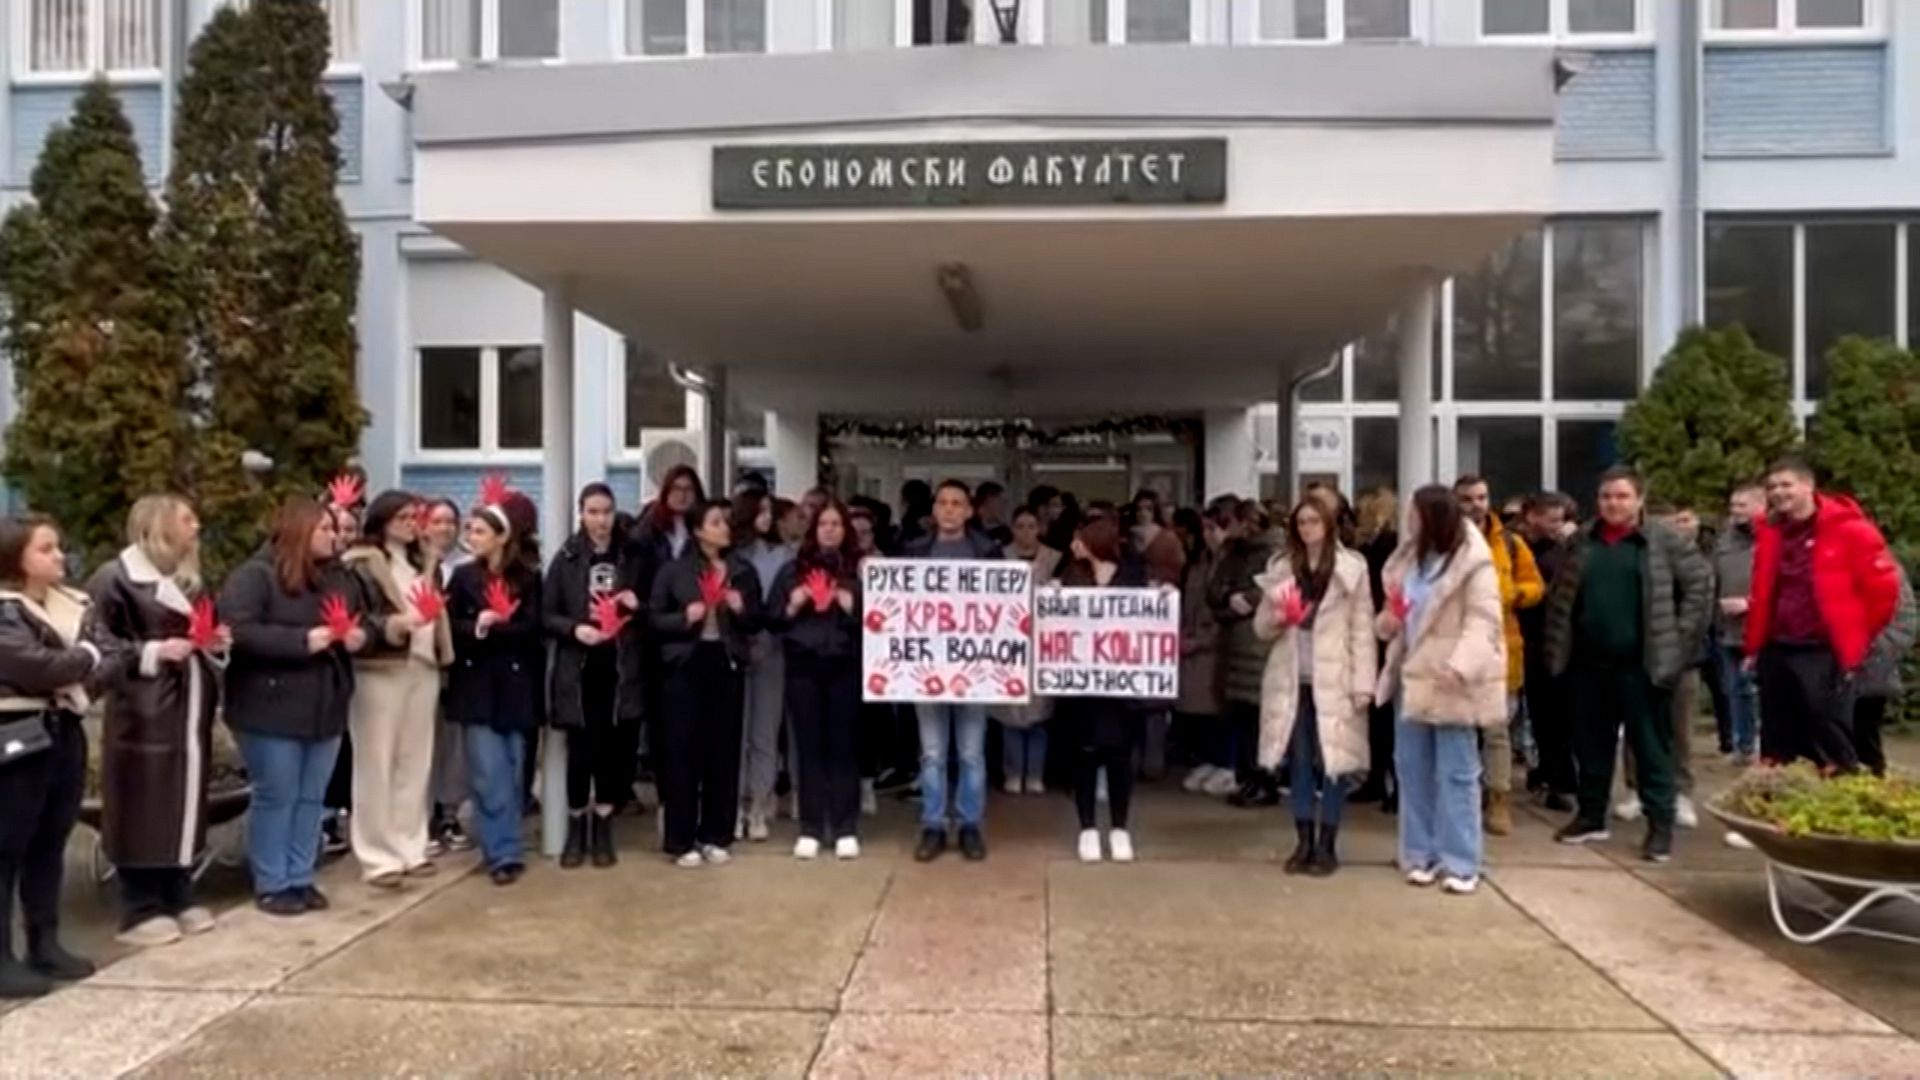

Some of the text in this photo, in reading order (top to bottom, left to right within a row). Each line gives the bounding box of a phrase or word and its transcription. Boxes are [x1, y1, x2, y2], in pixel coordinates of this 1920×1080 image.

[752, 153, 1185, 187] ЕКОНОМСКИ ФАКУЛТЕТ
[867, 565, 1028, 592] РУКЕ СЕ НЕ ПЕРУ
[904, 601, 1004, 634] КРВЉУ
[889, 637, 1027, 666] ВЕЋ ВОДОМ
[1039, 631, 1176, 665] НАС КОШТА
